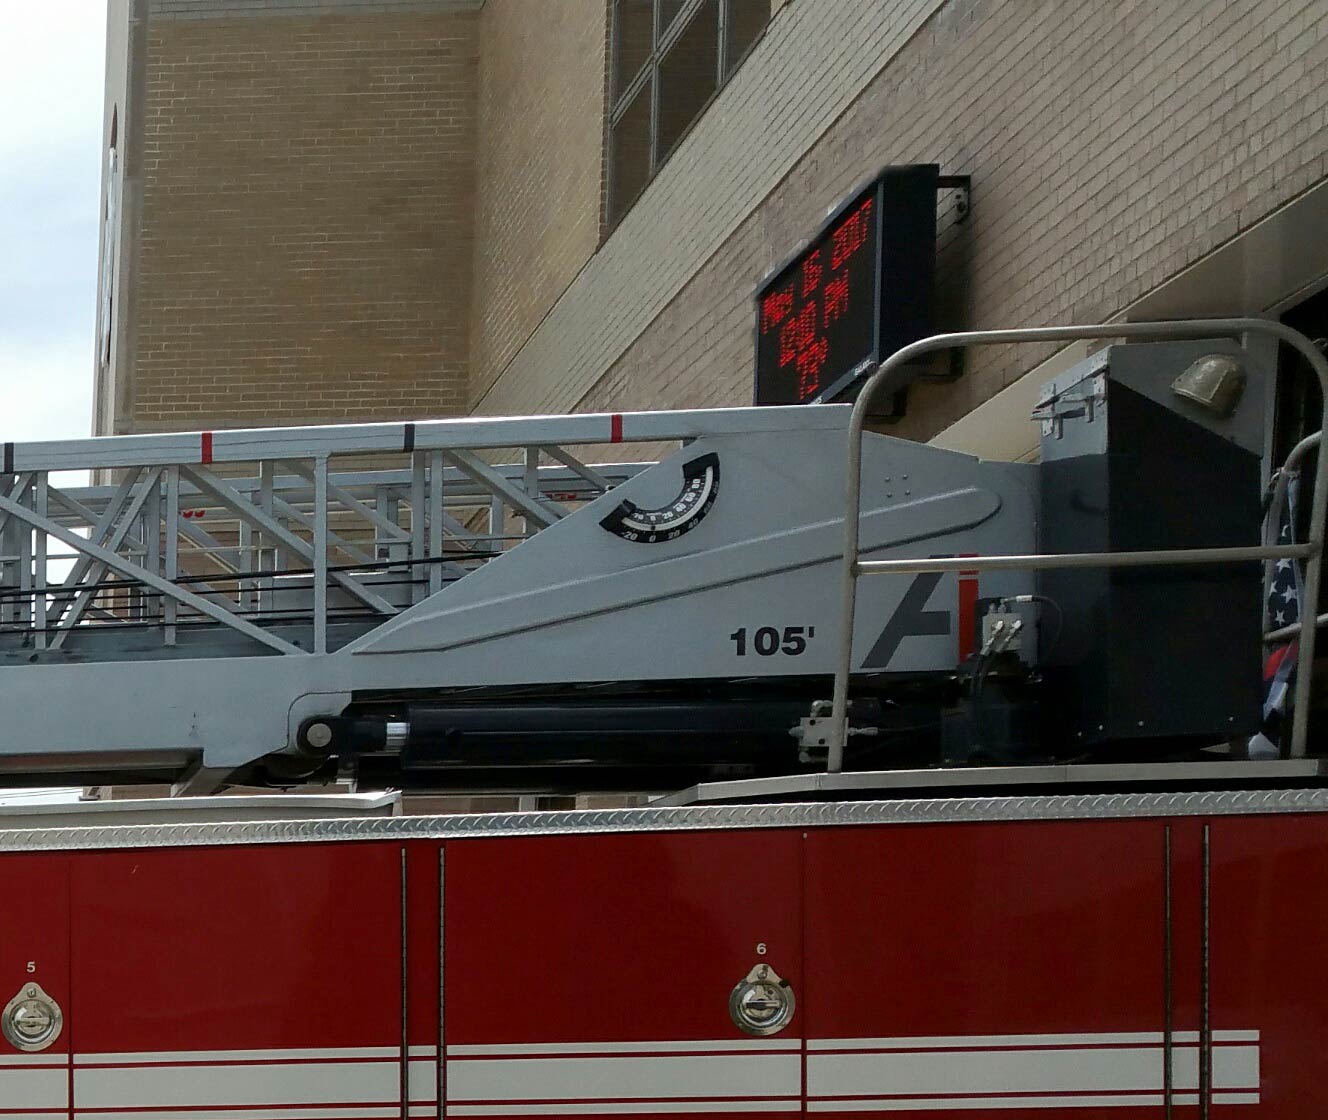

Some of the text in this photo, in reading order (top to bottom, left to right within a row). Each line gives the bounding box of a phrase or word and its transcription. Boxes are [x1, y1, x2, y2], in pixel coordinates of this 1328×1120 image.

[824, 268, 848, 328] PM
[730, 626, 815, 656] 105'
[756, 942, 767, 955] 6
[26, 961, 36, 973] 5
